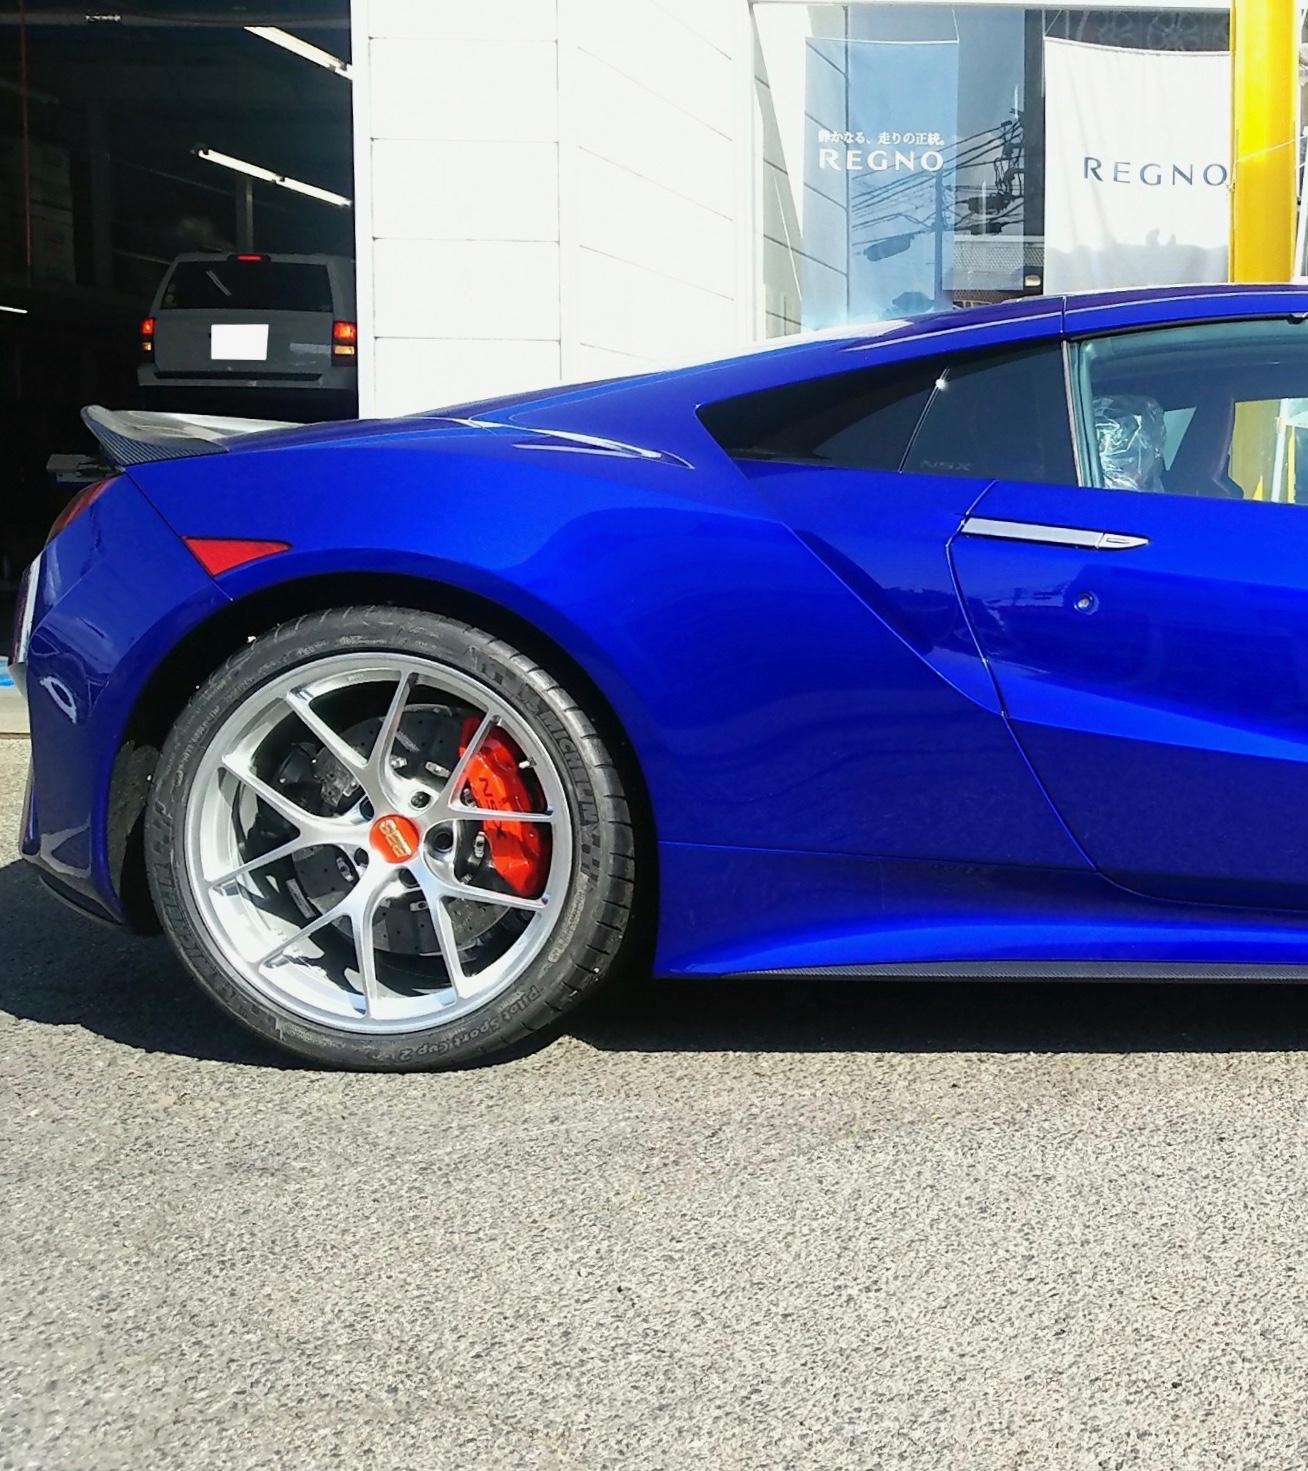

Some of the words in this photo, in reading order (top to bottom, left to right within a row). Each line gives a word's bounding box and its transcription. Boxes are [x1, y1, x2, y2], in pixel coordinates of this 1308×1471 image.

[818, 148, 944, 172] REGNO
[1083, 156, 1228, 187] REGNO
[920, 459, 972, 472] NSX
[538, 710, 600, 825] MICHELIN
[502, 984, 543, 1024] Pilot
[453, 1017, 501, 1048] Sport
[397, 1047, 414, 1063] 2
[415, 1041, 450, 1059] Cup
